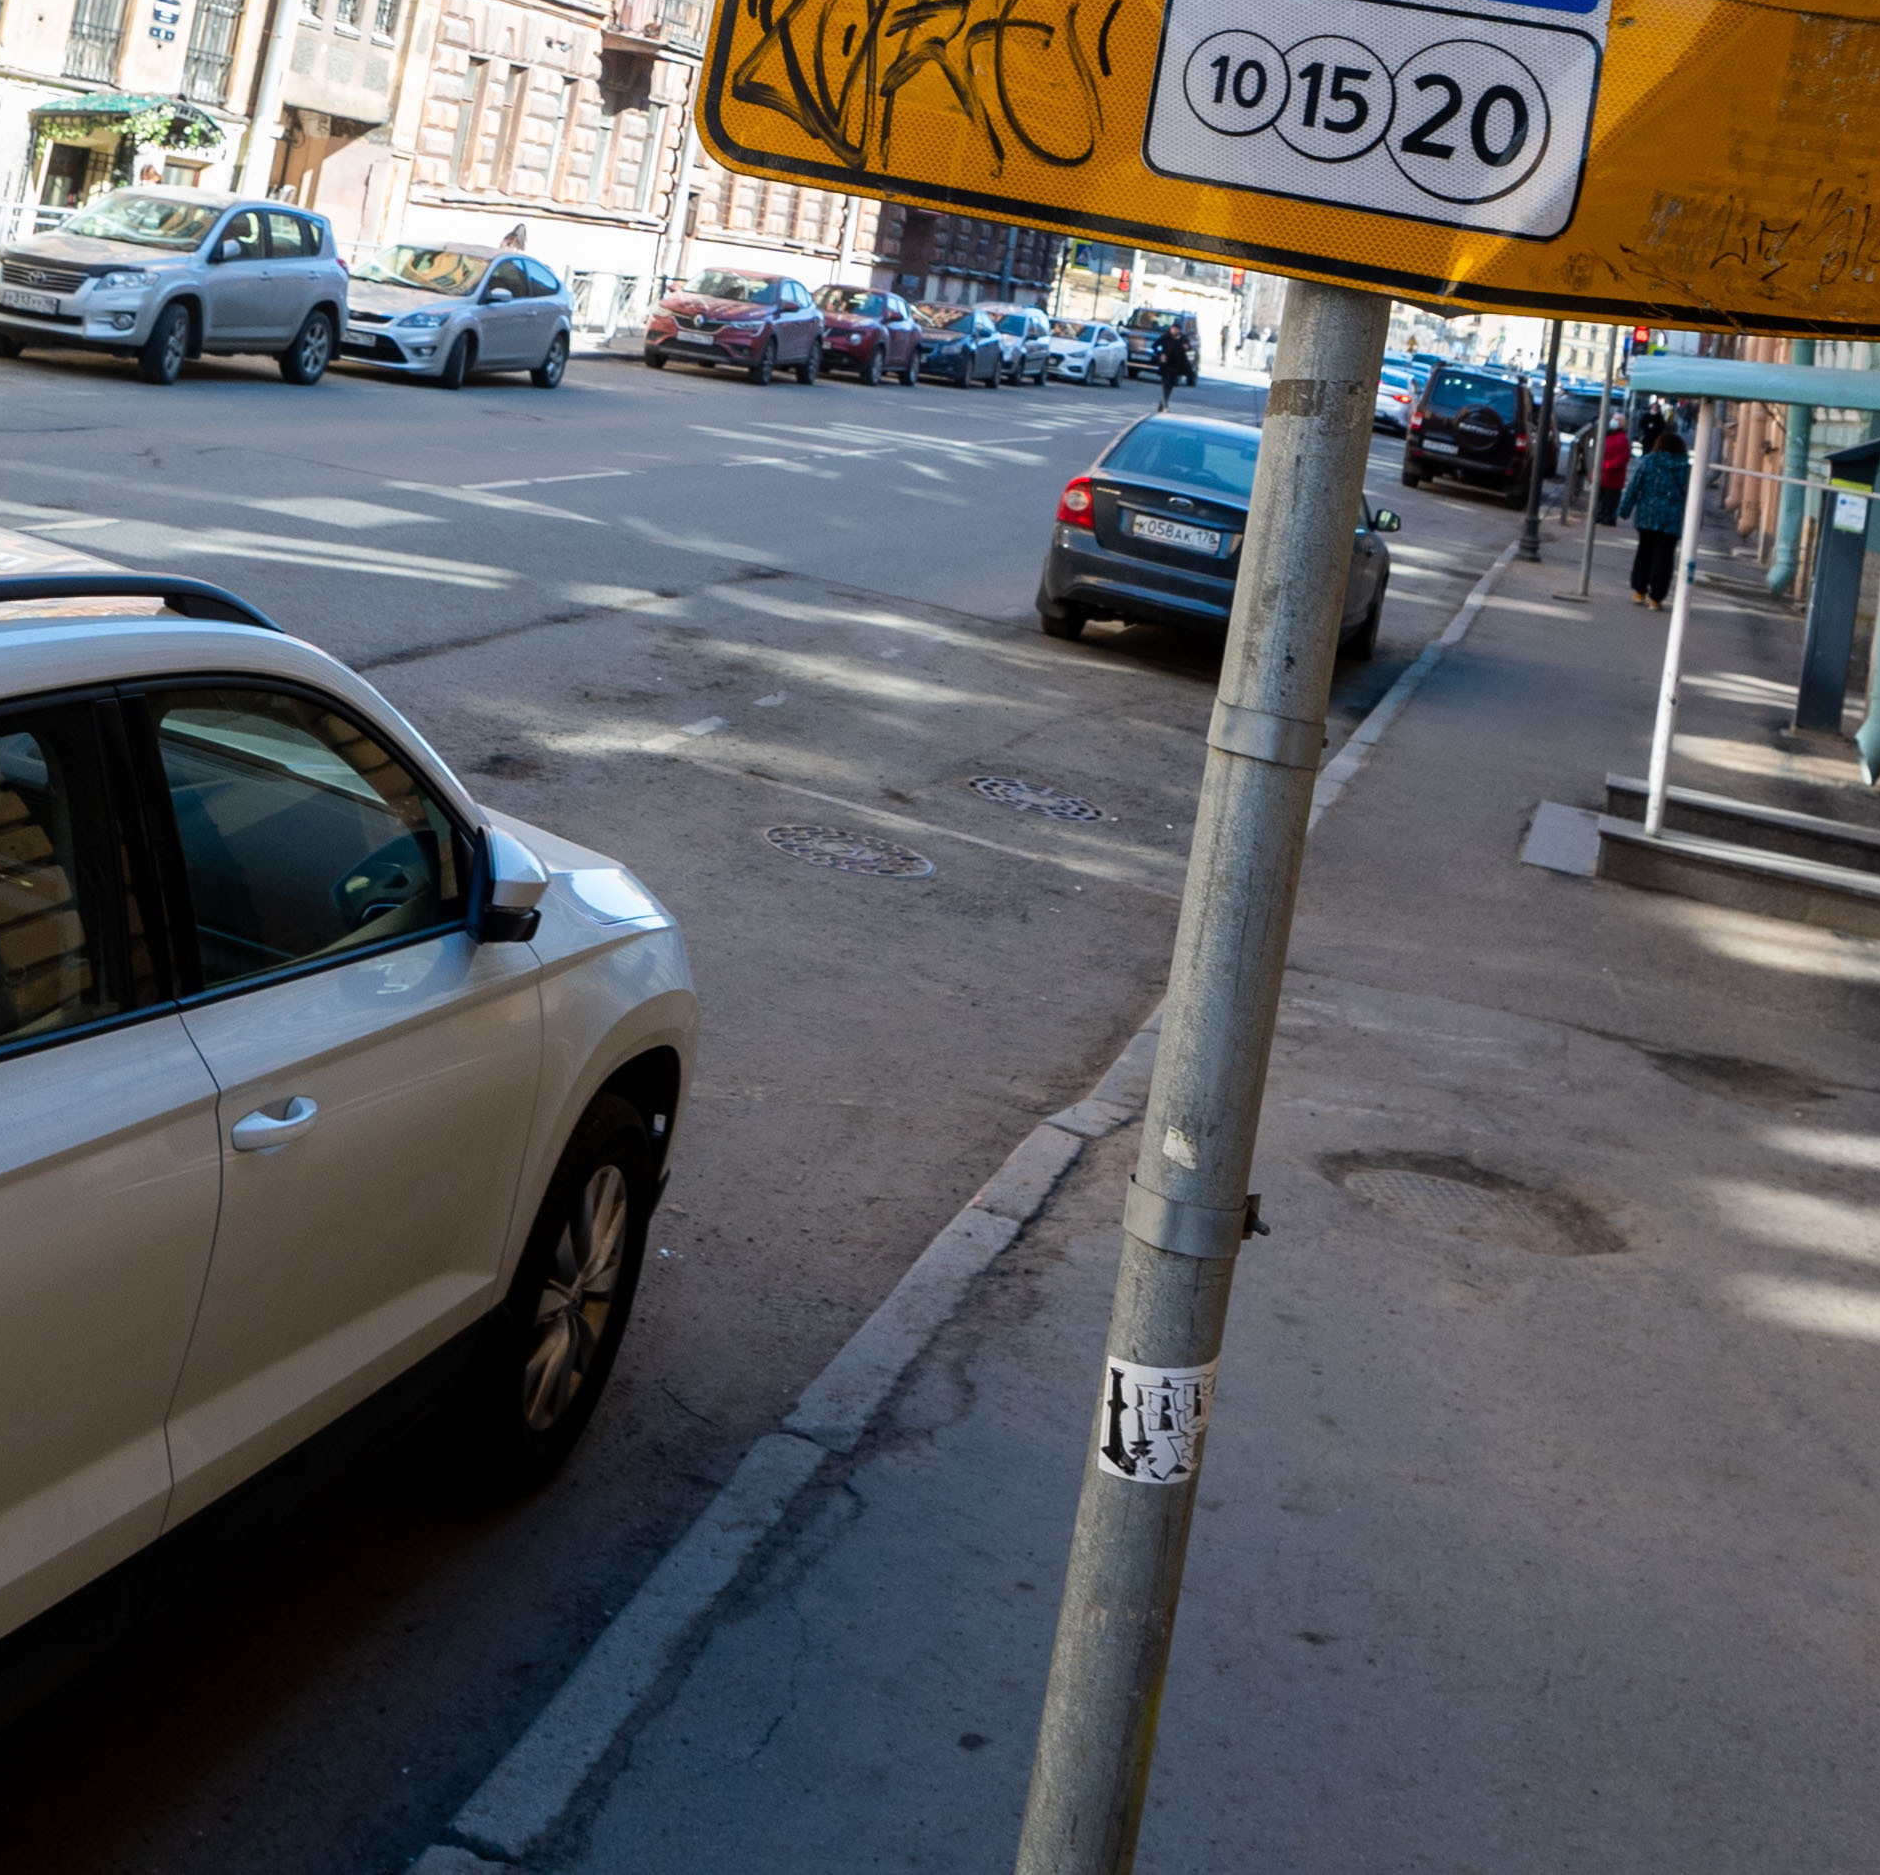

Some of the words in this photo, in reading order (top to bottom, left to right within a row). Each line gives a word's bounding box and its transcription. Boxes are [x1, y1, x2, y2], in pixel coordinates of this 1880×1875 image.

[1209, 55, 1268, 109] 10
[1298, 61, 1373, 134] 15
[1400, 73, 1529, 168] 20
